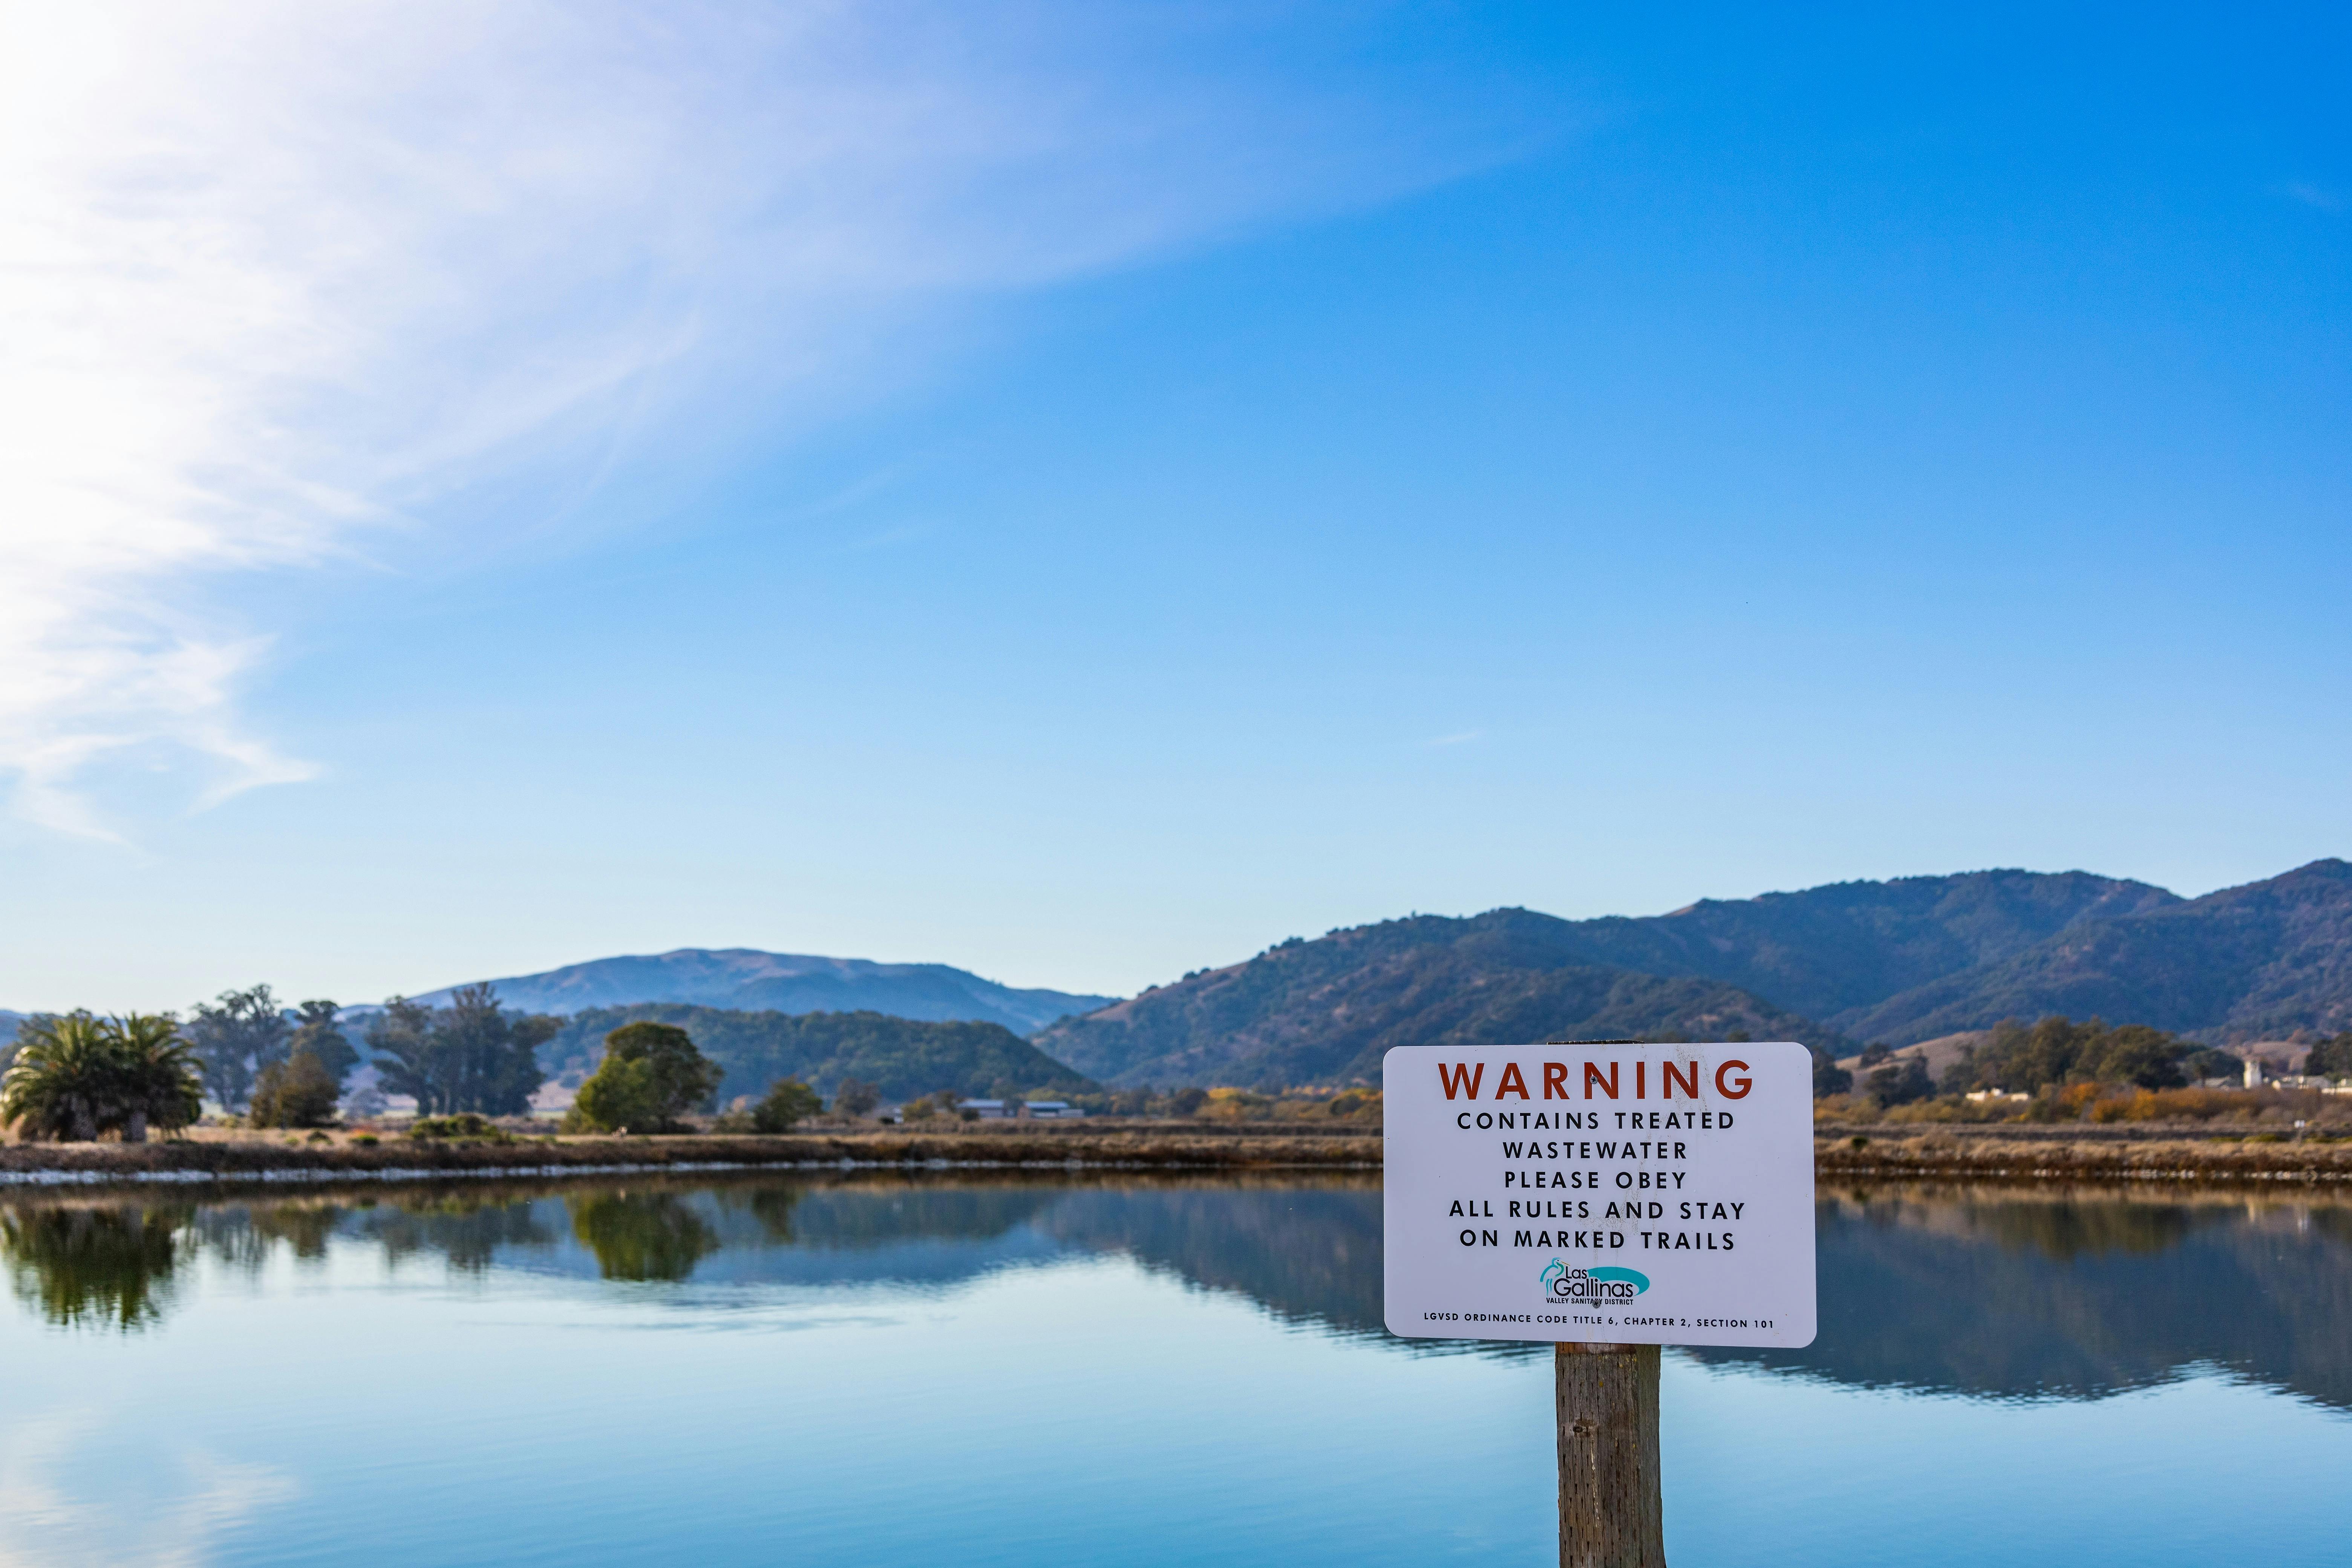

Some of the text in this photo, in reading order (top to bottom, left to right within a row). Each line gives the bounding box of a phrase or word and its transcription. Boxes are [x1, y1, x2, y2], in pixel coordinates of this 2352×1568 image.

[1438, 1060, 1752, 1100] WARNING
[1458, 1112, 1733, 1129] CONTAINS TREATED
[1503, 1142, 1686, 1159] WASTEWATER
[1505, 1171, 1686, 1188] PLEASE OBEY
[1449, 1200, 1744, 1219] ALL RULES AND STAY
[1460, 1230, 1733, 1250] ON MARKED TRAILS
[1566, 1266, 1587, 1279] Las
[1554, 1278, 1633, 1297] Gallinas
[1465, 1314, 1530, 1322] ORDINANCE
[1608, 1317, 1617, 1326] 6,
[1625, 1317, 1674, 1326] CHAPTER
[1681, 1319, 1690, 1327] 2,
